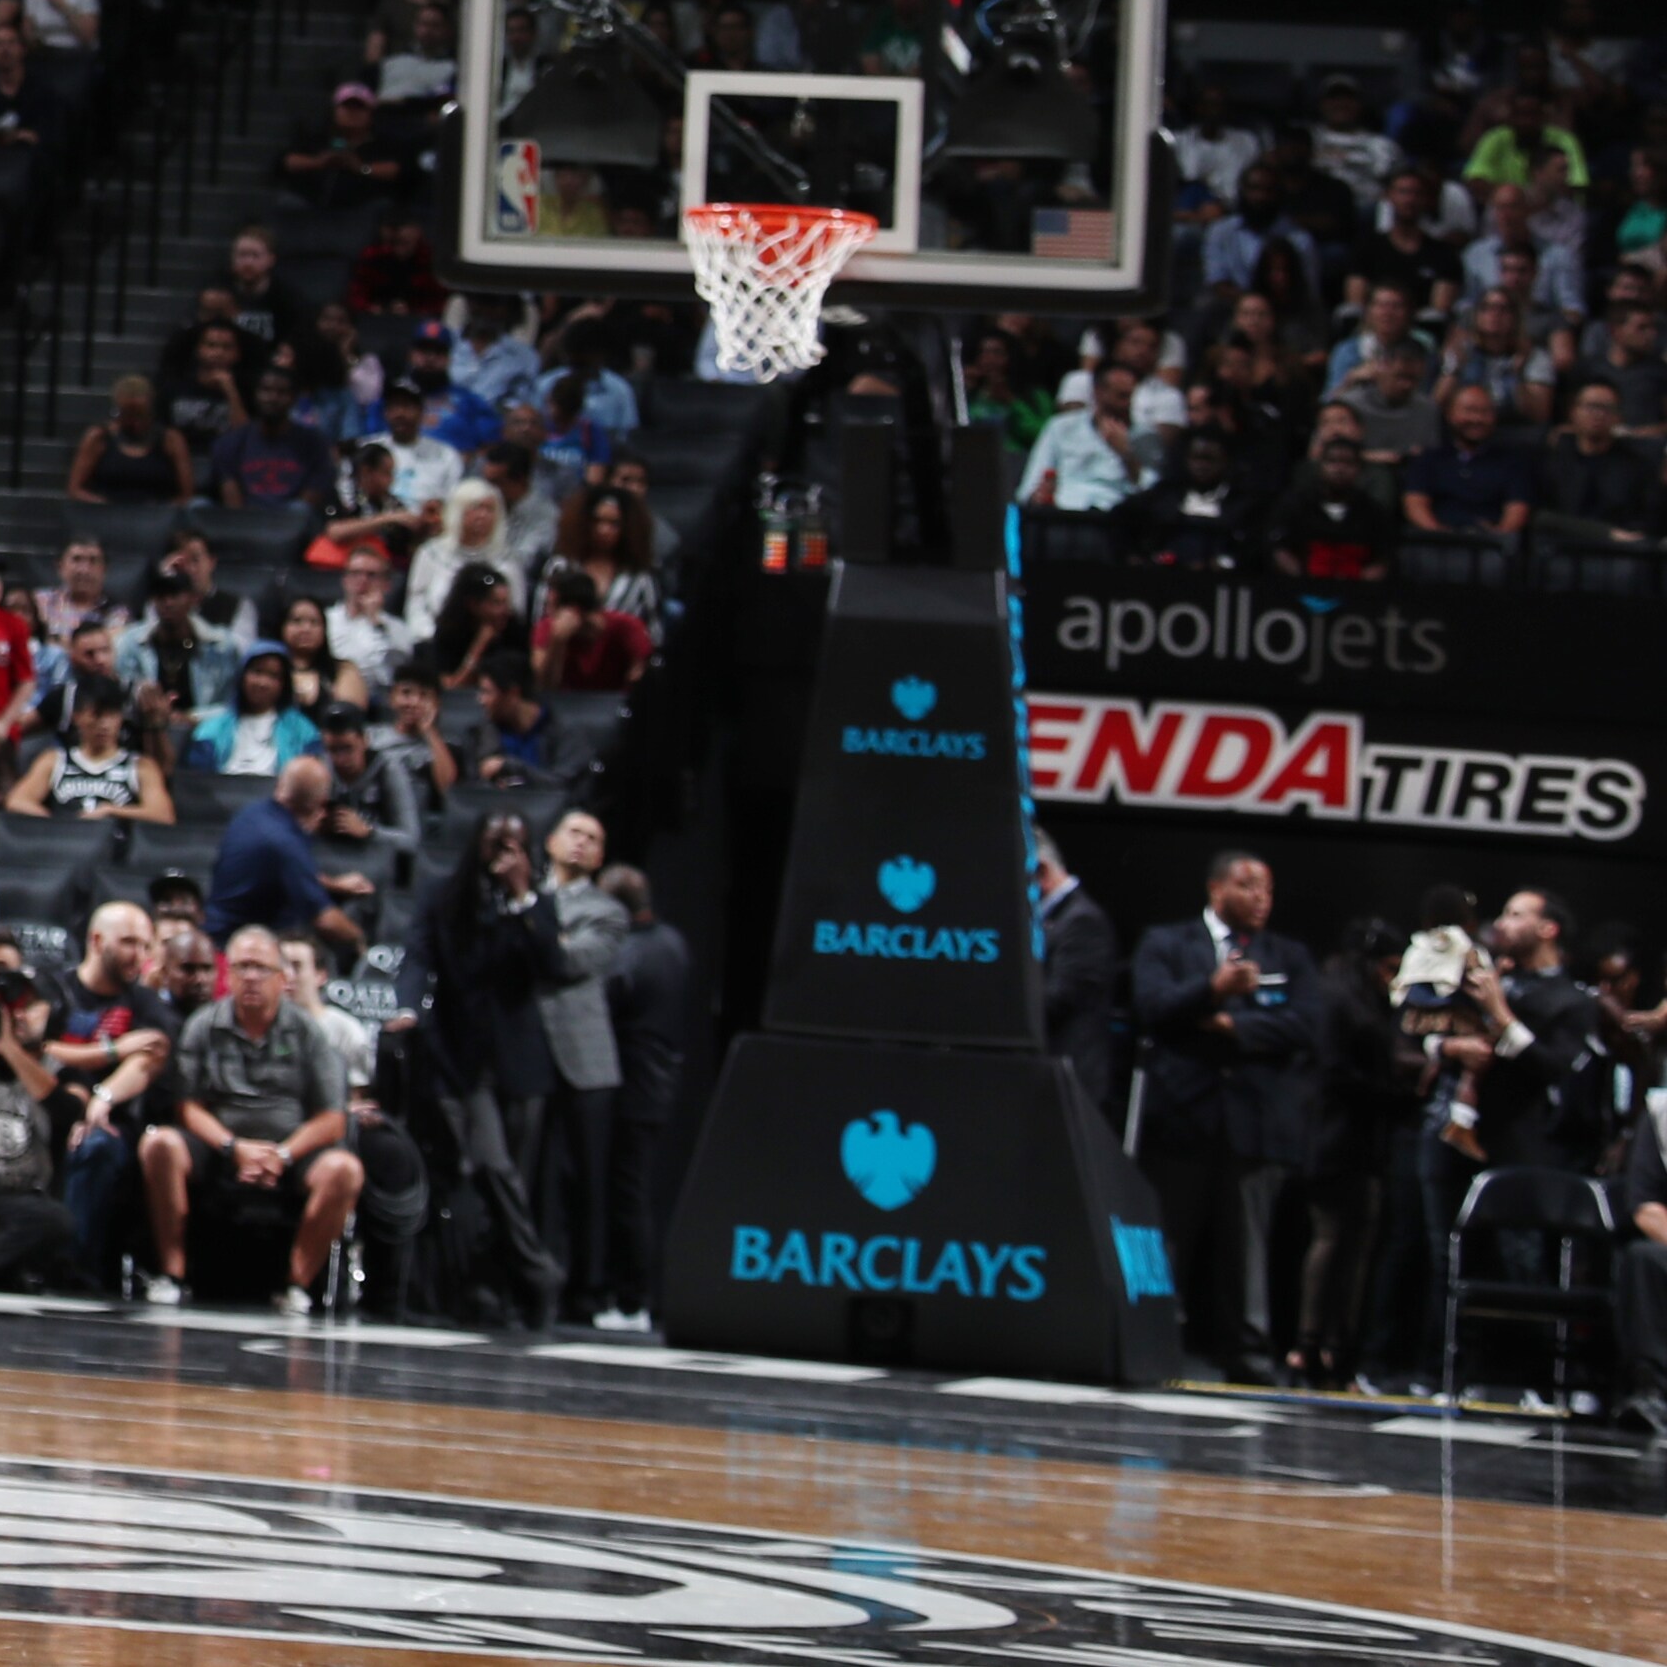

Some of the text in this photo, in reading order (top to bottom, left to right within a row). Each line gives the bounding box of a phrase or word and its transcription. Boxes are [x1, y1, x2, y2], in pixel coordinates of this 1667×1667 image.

[1056, 584, 1448, 684] apollojets
[842, 726, 986, 761] BARCLAYS
[1373, 755, 1633, 830] TIRES
[813, 919, 1000, 964] BARCLAYS
[729, 1224, 1048, 1302] BARCLAYS
